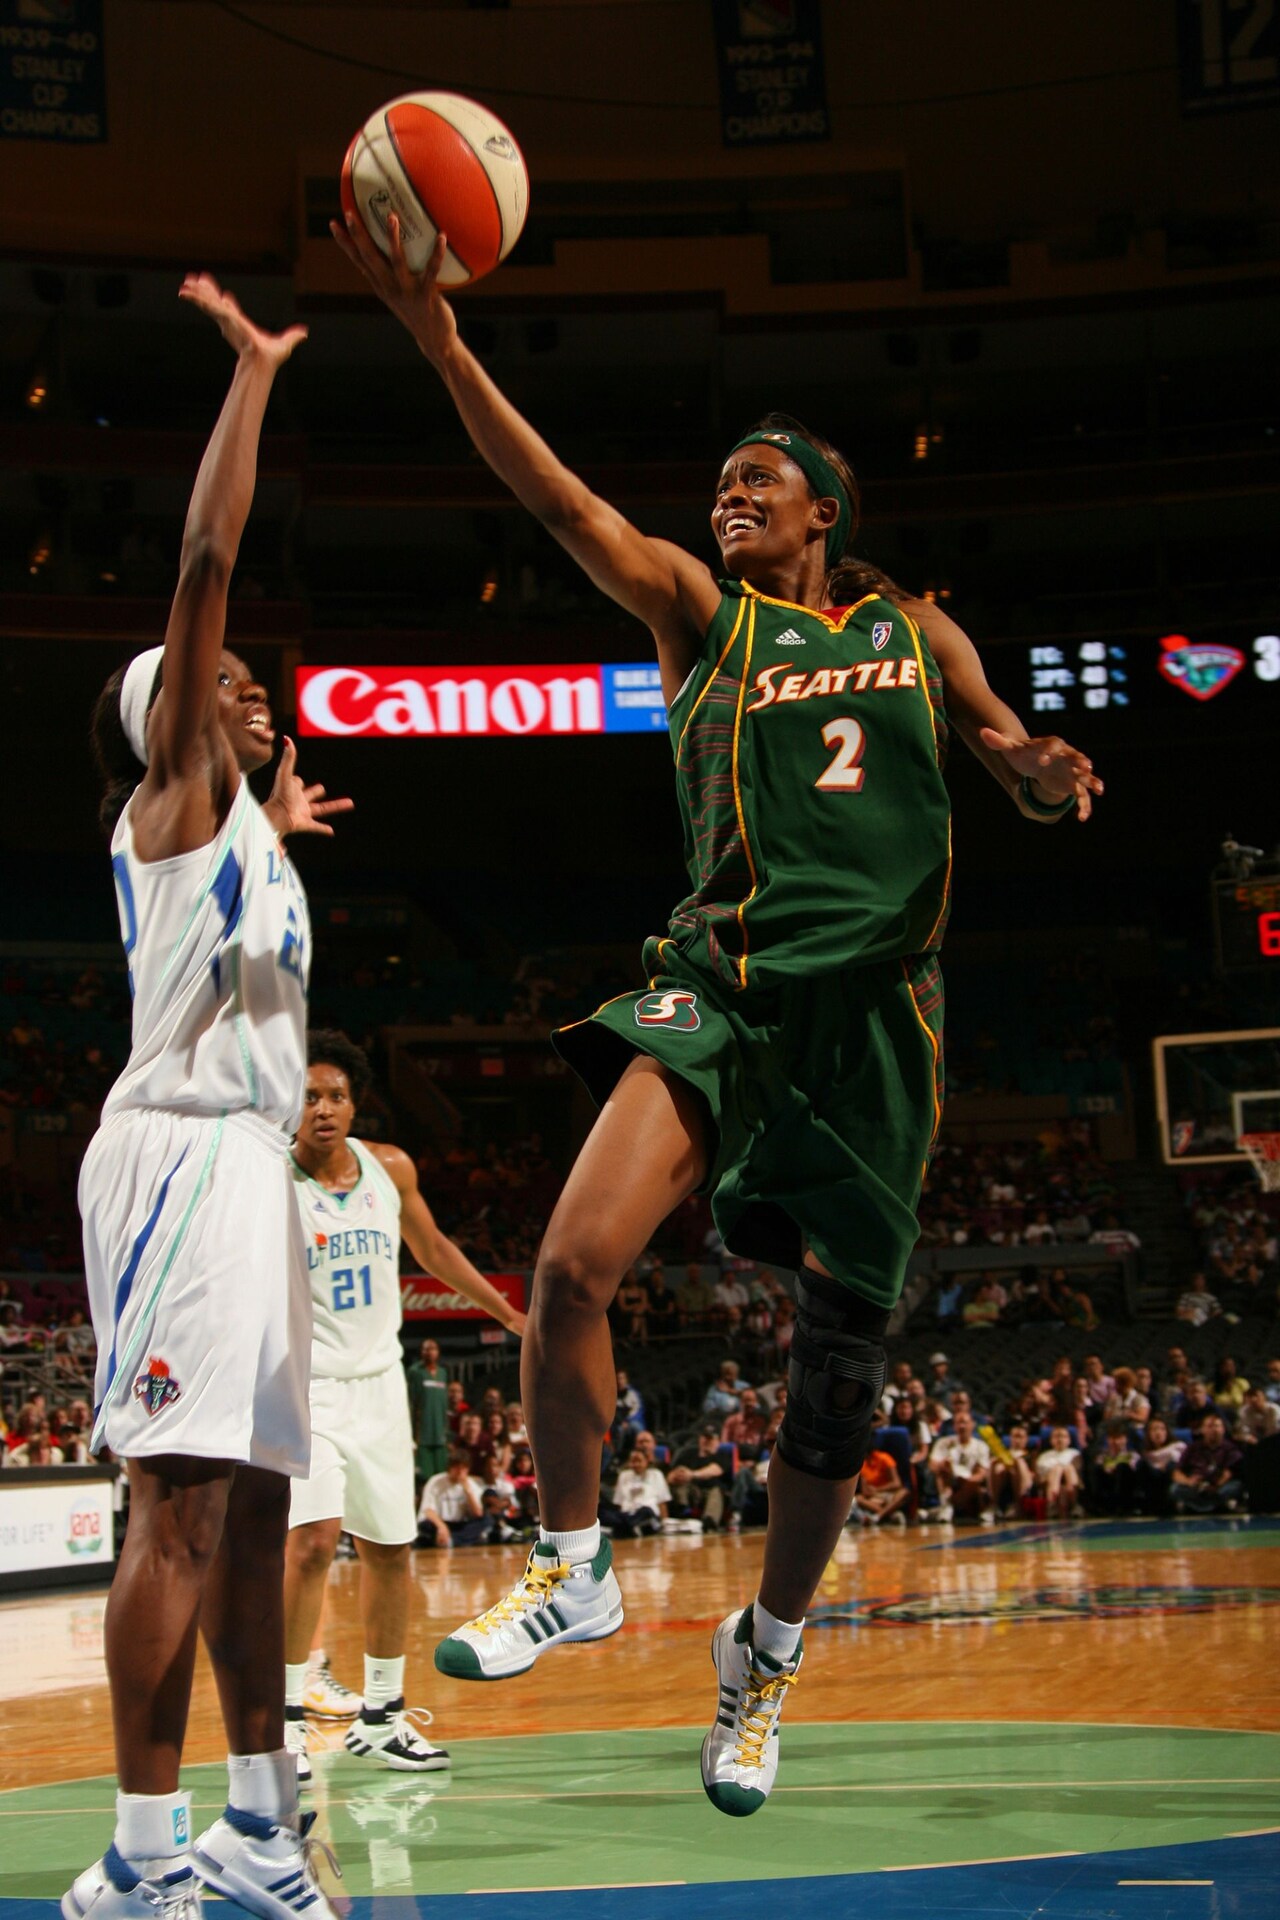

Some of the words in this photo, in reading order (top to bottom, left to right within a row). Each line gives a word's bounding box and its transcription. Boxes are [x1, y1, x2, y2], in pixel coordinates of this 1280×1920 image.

[11, 54, 86, 83] STANLEY
[735, 65, 809, 93] STANLEY
[32, 82, 69, 109] CUP
[775, 637, 807, 646] adidas
[300, 667, 601, 735] Canon
[746, 657, 920, 714] SEATTLE
[814, 716, 866, 792] 2
[332, 1264, 372, 1312] 21
